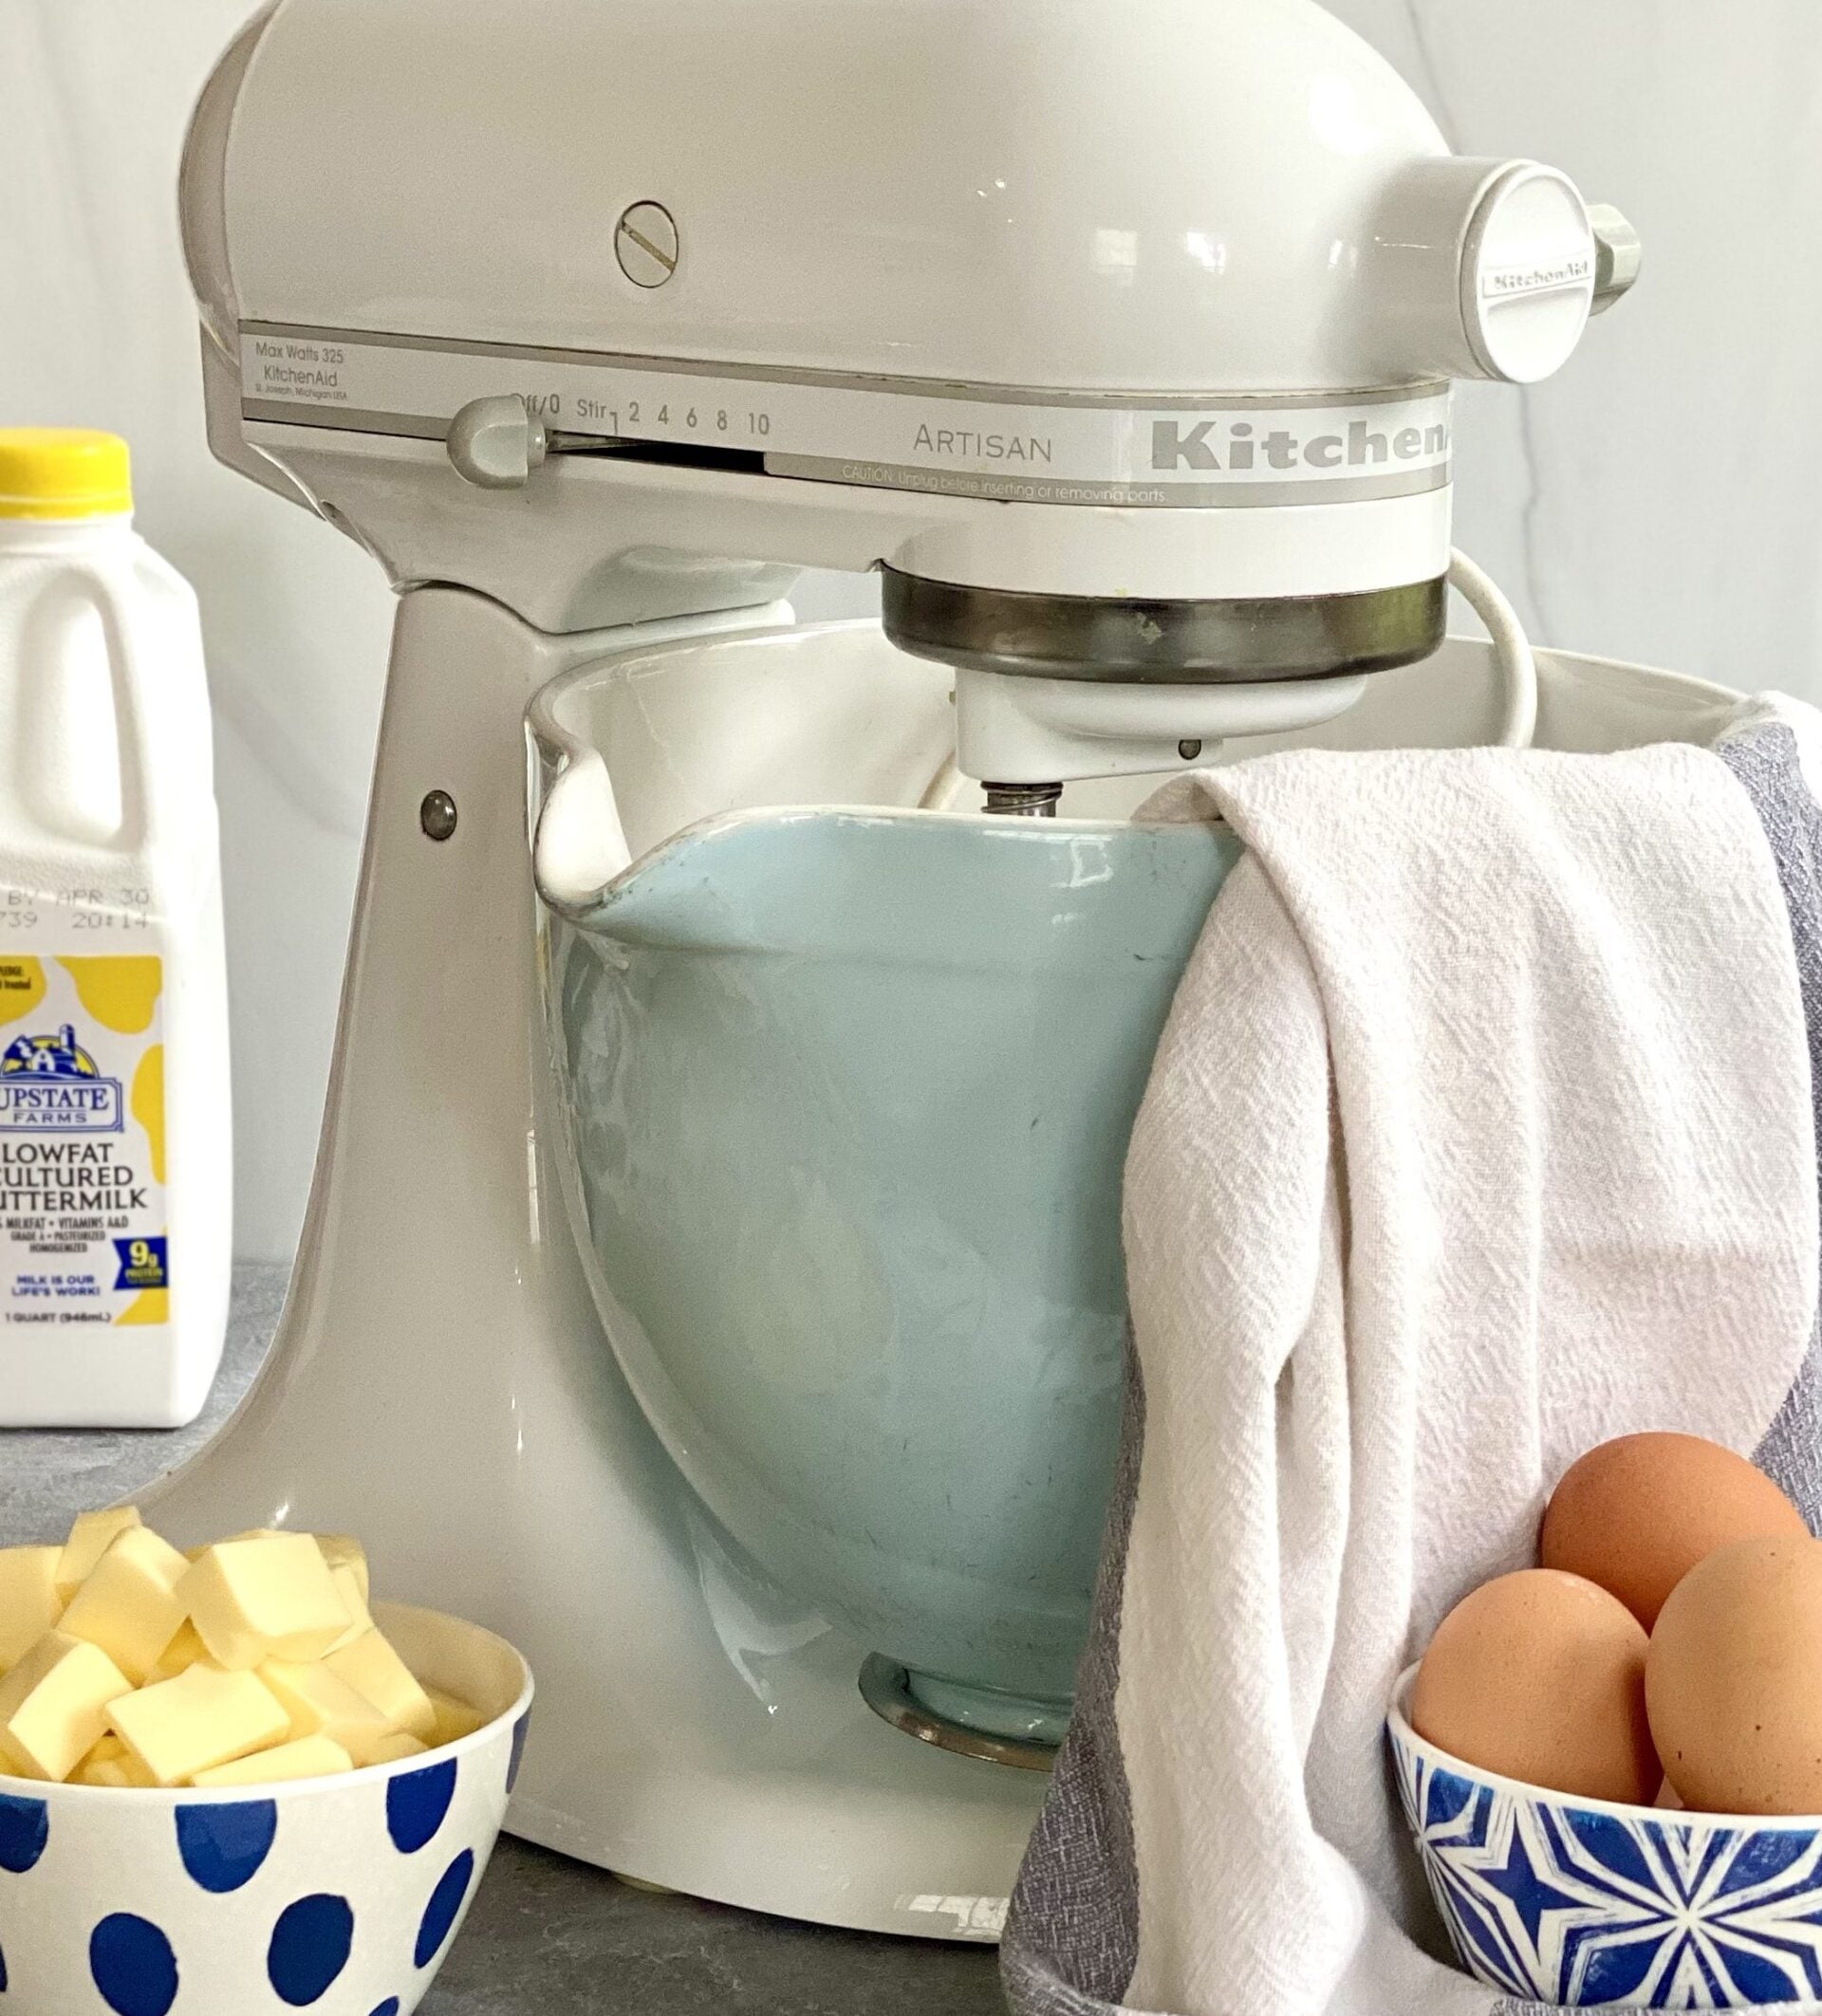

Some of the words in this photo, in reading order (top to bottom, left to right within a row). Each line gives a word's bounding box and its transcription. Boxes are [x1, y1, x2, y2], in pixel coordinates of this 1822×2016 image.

[1494, 260, 1588, 289] KitchenAid
[255, 342, 284, 359] Max
[287, 344, 320, 362] Watts
[323, 347, 344, 364] 325
[264, 365, 338, 388] KitchenAid
[576, 398, 606, 418] Stir
[629, 401, 640, 422] 2
[658, 404, 669, 425] 4
[686, 408, 698, 428] 6
[716, 410, 728, 431] 8
[749, 413, 770, 435] 10
[913, 423, 1052, 463] ARTISAN
[1151, 420, 1447, 470] Kitchen
[899, 471, 939, 490] Unplug
[940, 477, 978, 492] before
[981, 481, 1034, 500] inserting
[1038, 487, 1051, 497] or
[1055, 486, 1124, 504] removing
[1127, 488, 1166, 504] parts
[56, 888, 103, 906] APR
[121, 888, 150, 905] 30
[71, 912, 148, 929] 20:14
[13, 1112, 87, 1123] FARMS
[3, 1142, 113, 1164] LOWFAT
[0, 1165, 133, 1188] ULTURED
[6, 1217, 46, 1230] MILKFAT
[58, 1216, 103, 1230] VITAMINS
[54, 1230, 105, 1242] PASTEURIZED
[29, 1242, 87, 1253] HOMOGENIZED
[17, 1275, 46, 1285] MILK
[51, 1275, 63, 1285] IS
[66, 1275, 94, 1285] OUR
[11, 1286, 50, 1296] LIFE'S
[56, 1286, 100, 1296] WORK!
[13, 1312, 56, 1322] QUART
